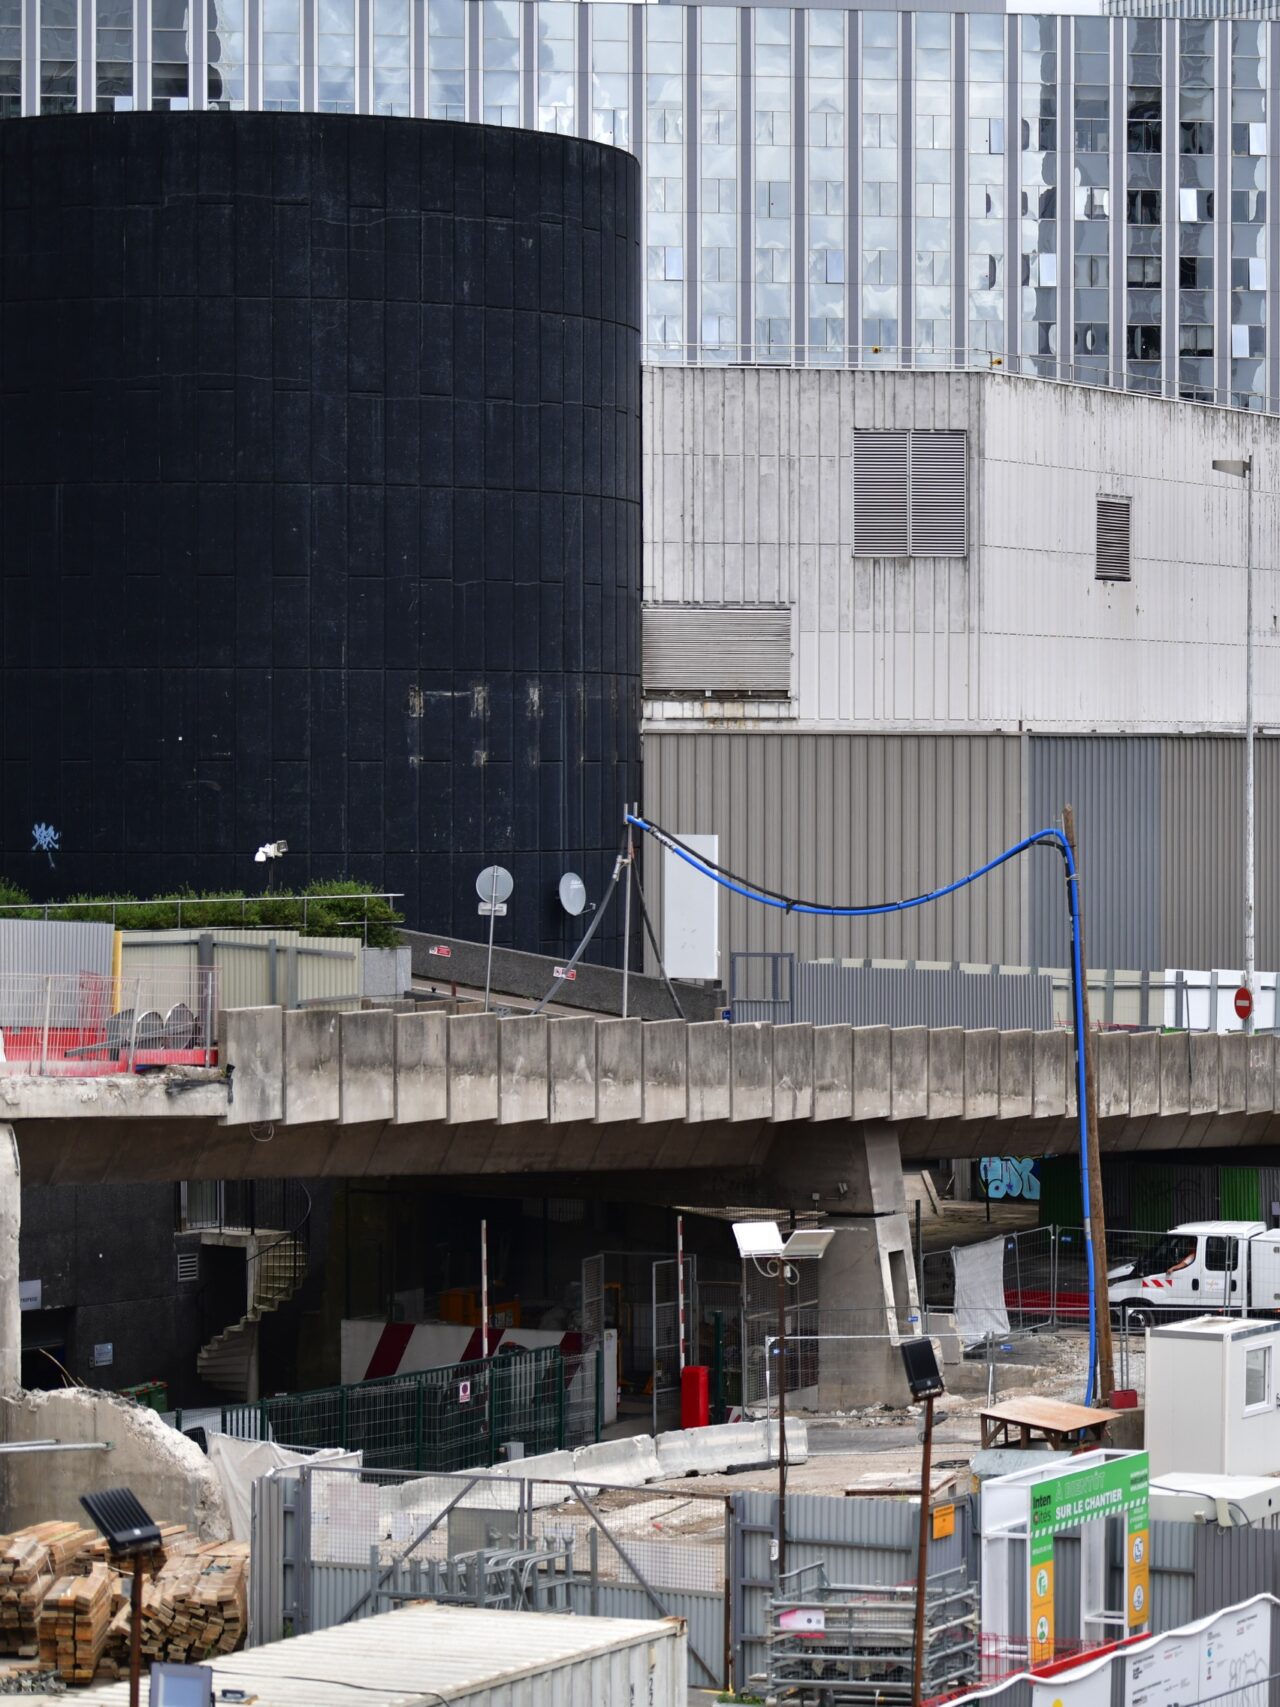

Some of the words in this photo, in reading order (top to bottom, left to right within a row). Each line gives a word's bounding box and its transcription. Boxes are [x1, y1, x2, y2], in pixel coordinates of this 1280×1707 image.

[1056, 1503, 1072, 1520] SUR
[1073, 1499, 1084, 1514] LE
[1084, 1488, 1123, 1511] CHANTIER
